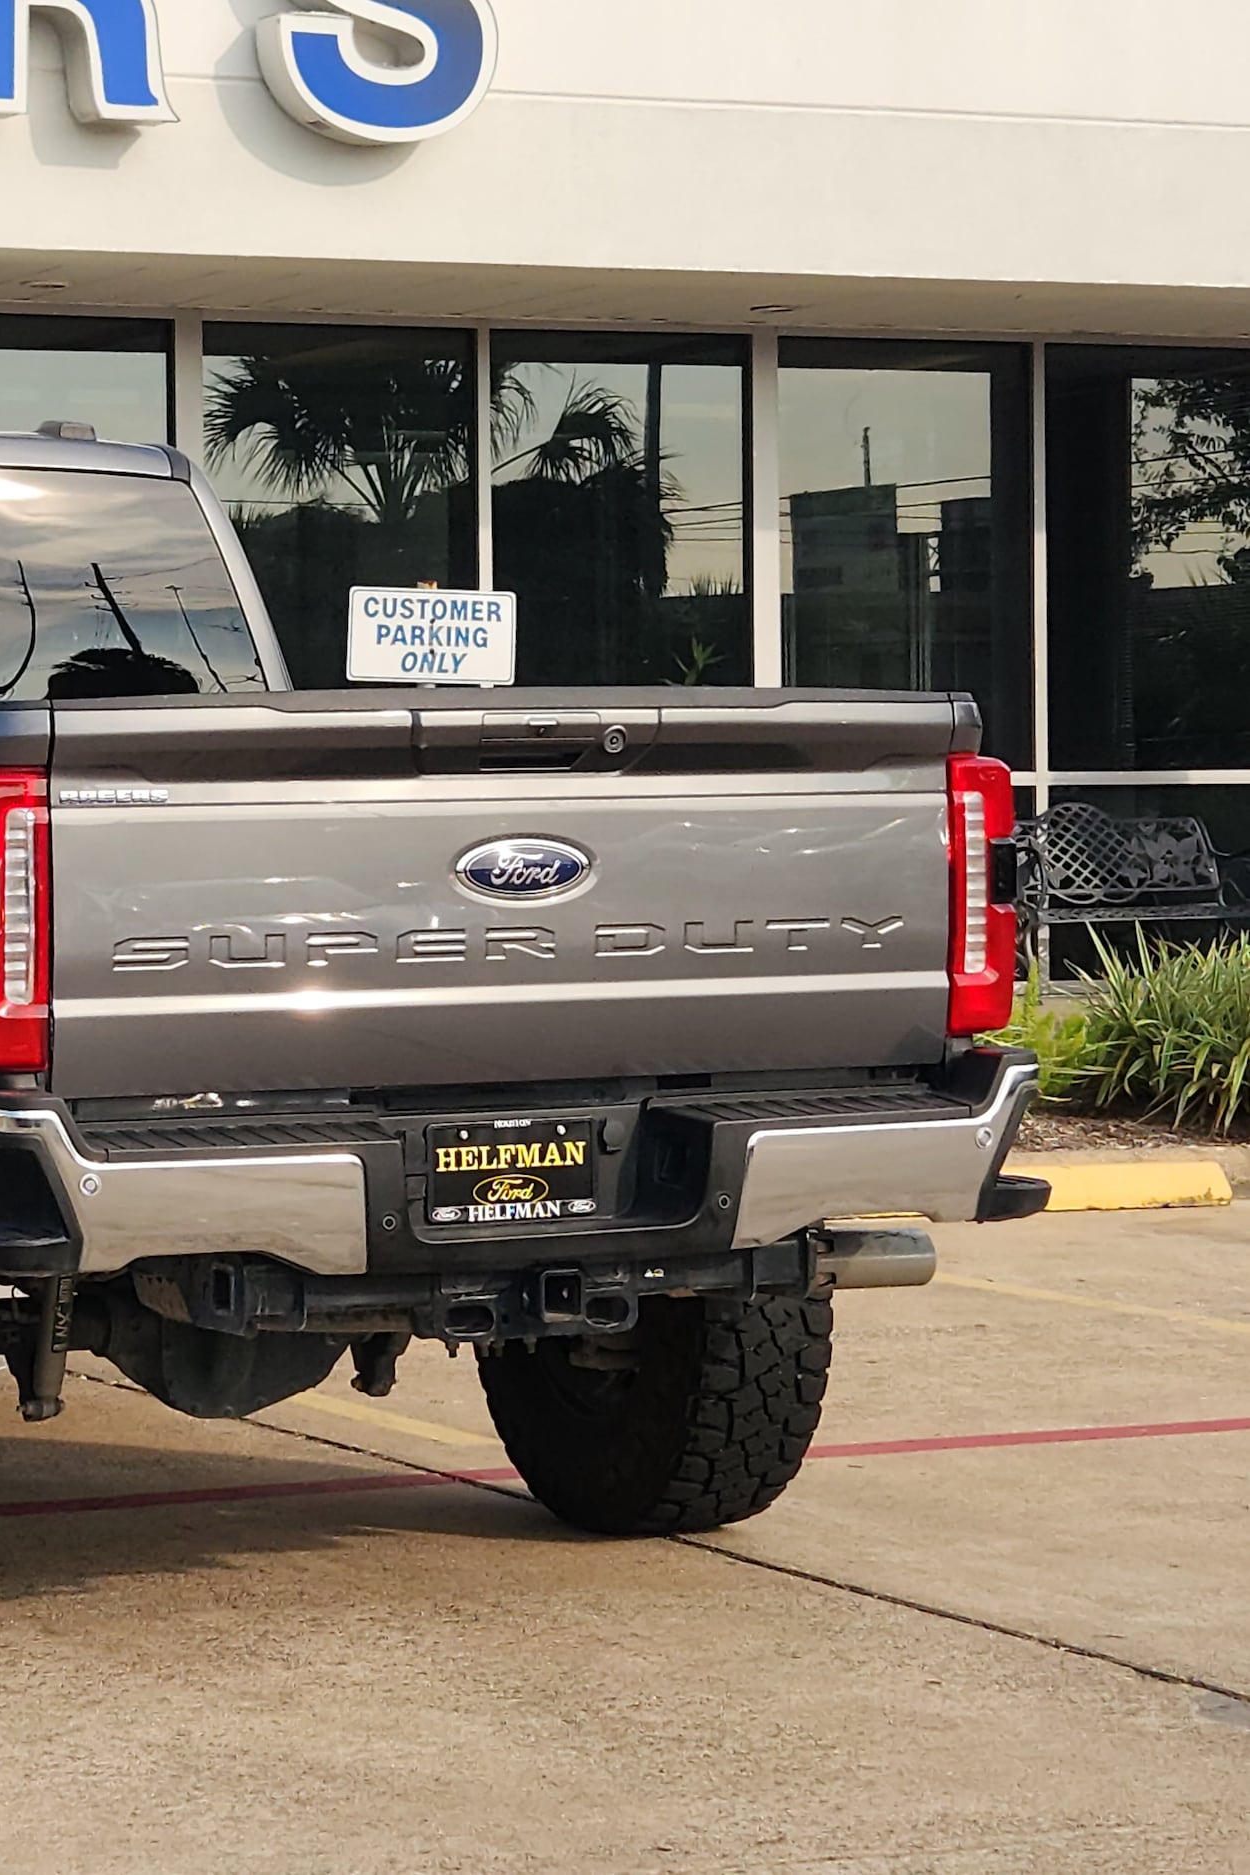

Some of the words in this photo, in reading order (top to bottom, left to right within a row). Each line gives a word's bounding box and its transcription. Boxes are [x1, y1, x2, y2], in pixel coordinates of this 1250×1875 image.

[363, 597, 502, 622] CUSTOMER
[375, 624, 489, 648] PARKING
[400, 651, 468, 674] ONLY
[490, 850, 562, 886] Ford
[112, 926, 556, 972] SUPER
[594, 915, 904, 956] DUTY
[435, 1141, 587, 1173] HELFMAN
[486, 1178, 535, 1202] Ford
[467, 1200, 562, 1222] HELFMAN
